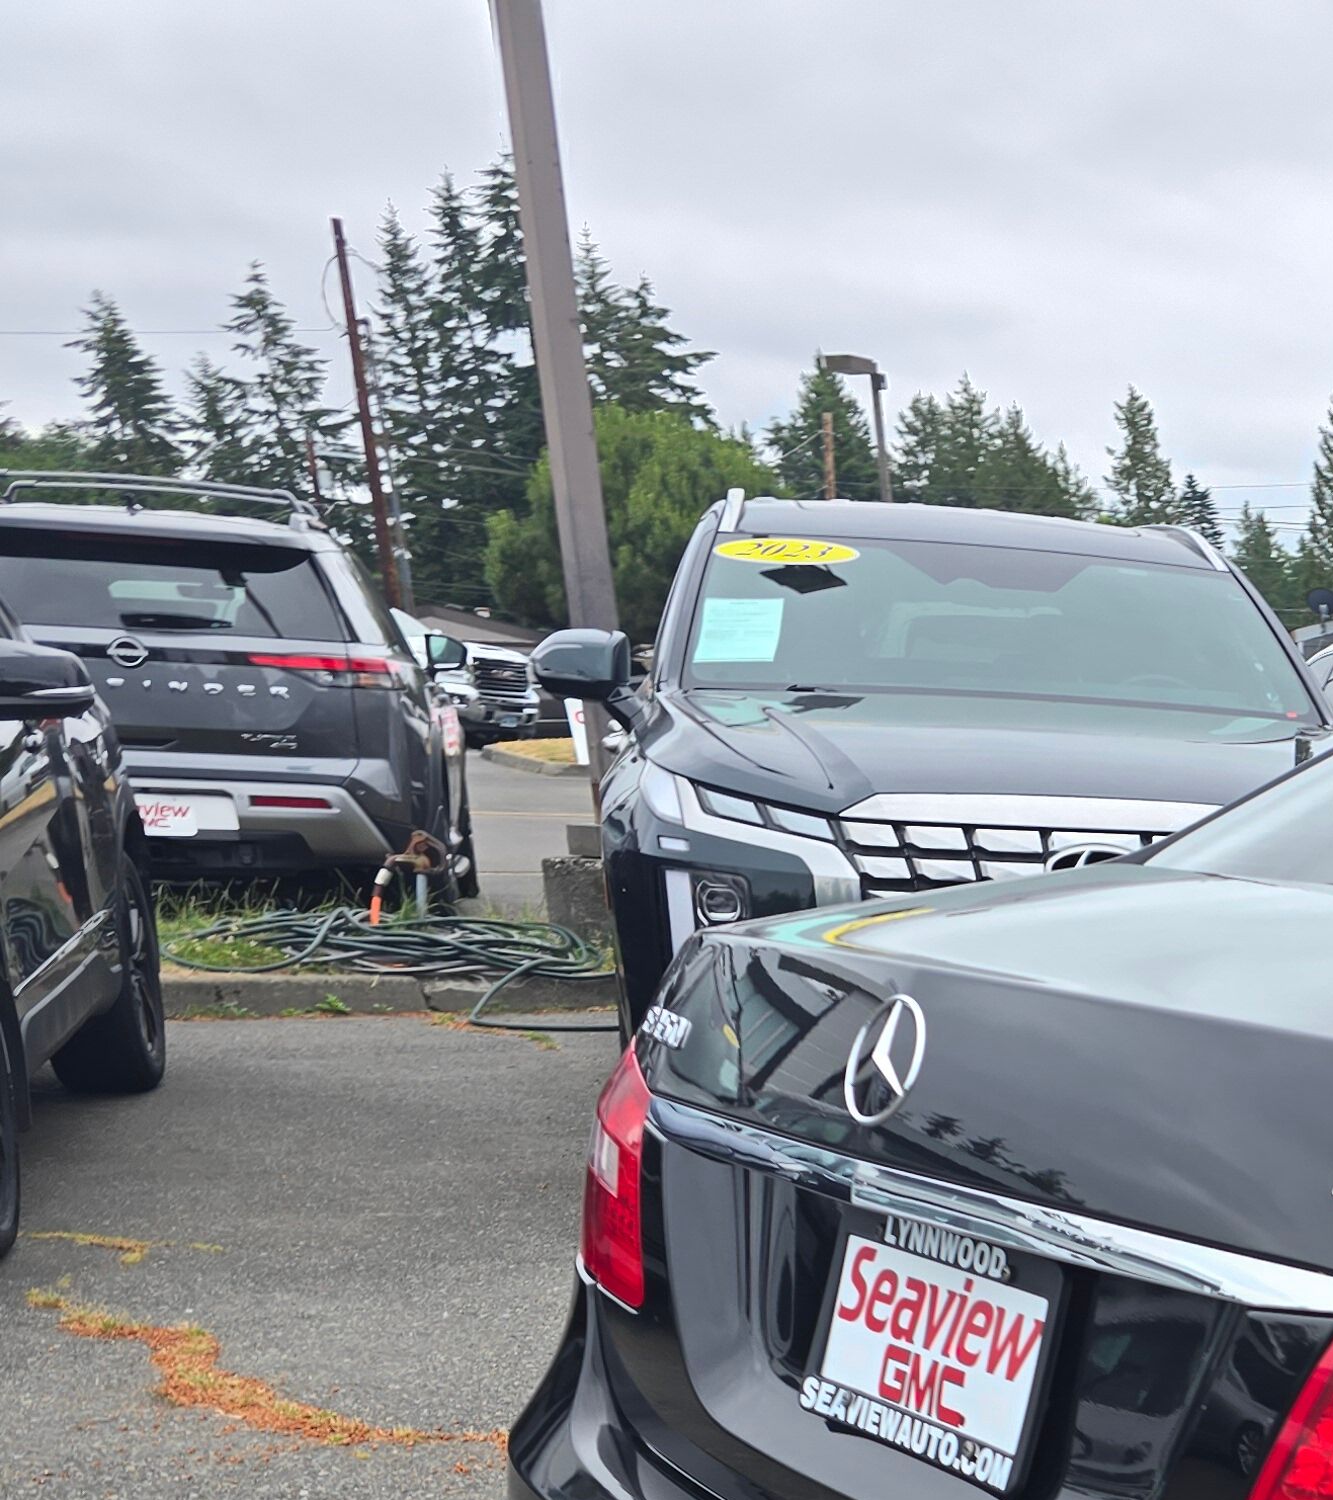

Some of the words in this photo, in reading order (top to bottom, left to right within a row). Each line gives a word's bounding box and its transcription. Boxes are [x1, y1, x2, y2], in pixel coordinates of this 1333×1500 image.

[735, 542, 833, 559] 2023
[137, 801, 191, 817] view
[883, 1214, 1008, 1279] LYNNWOOD
[837, 1245, 1046, 1383] Seaview
[878, 1343, 967, 1428] GMC
[799, 1375, 1014, 1491] SEAVIEWAUTO.COM
